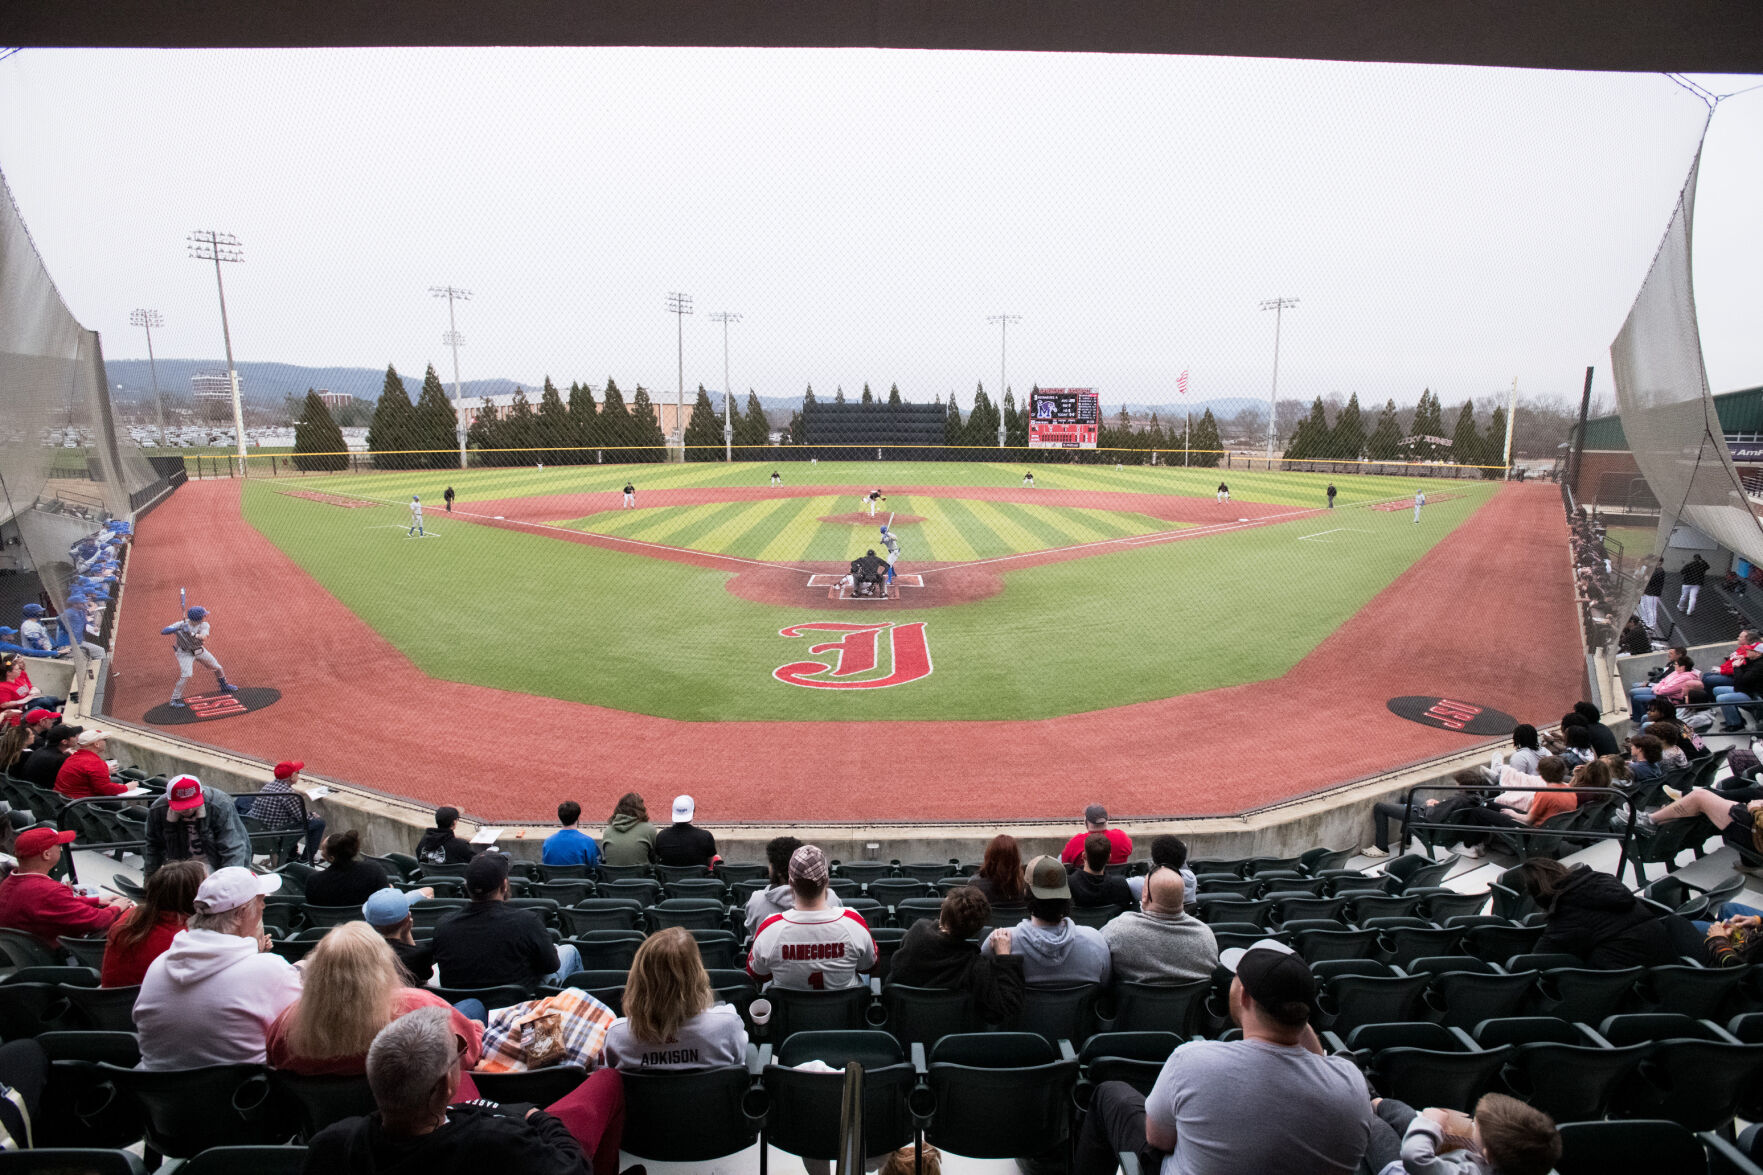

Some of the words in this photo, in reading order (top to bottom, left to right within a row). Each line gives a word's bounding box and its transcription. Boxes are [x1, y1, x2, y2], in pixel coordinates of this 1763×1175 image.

[184, 694, 248, 717] JSU
[1423, 699, 1483, 729] JSU
[781, 942, 845, 961] GAMECOCKS
[641, 1048, 699, 1067] ADKISON
